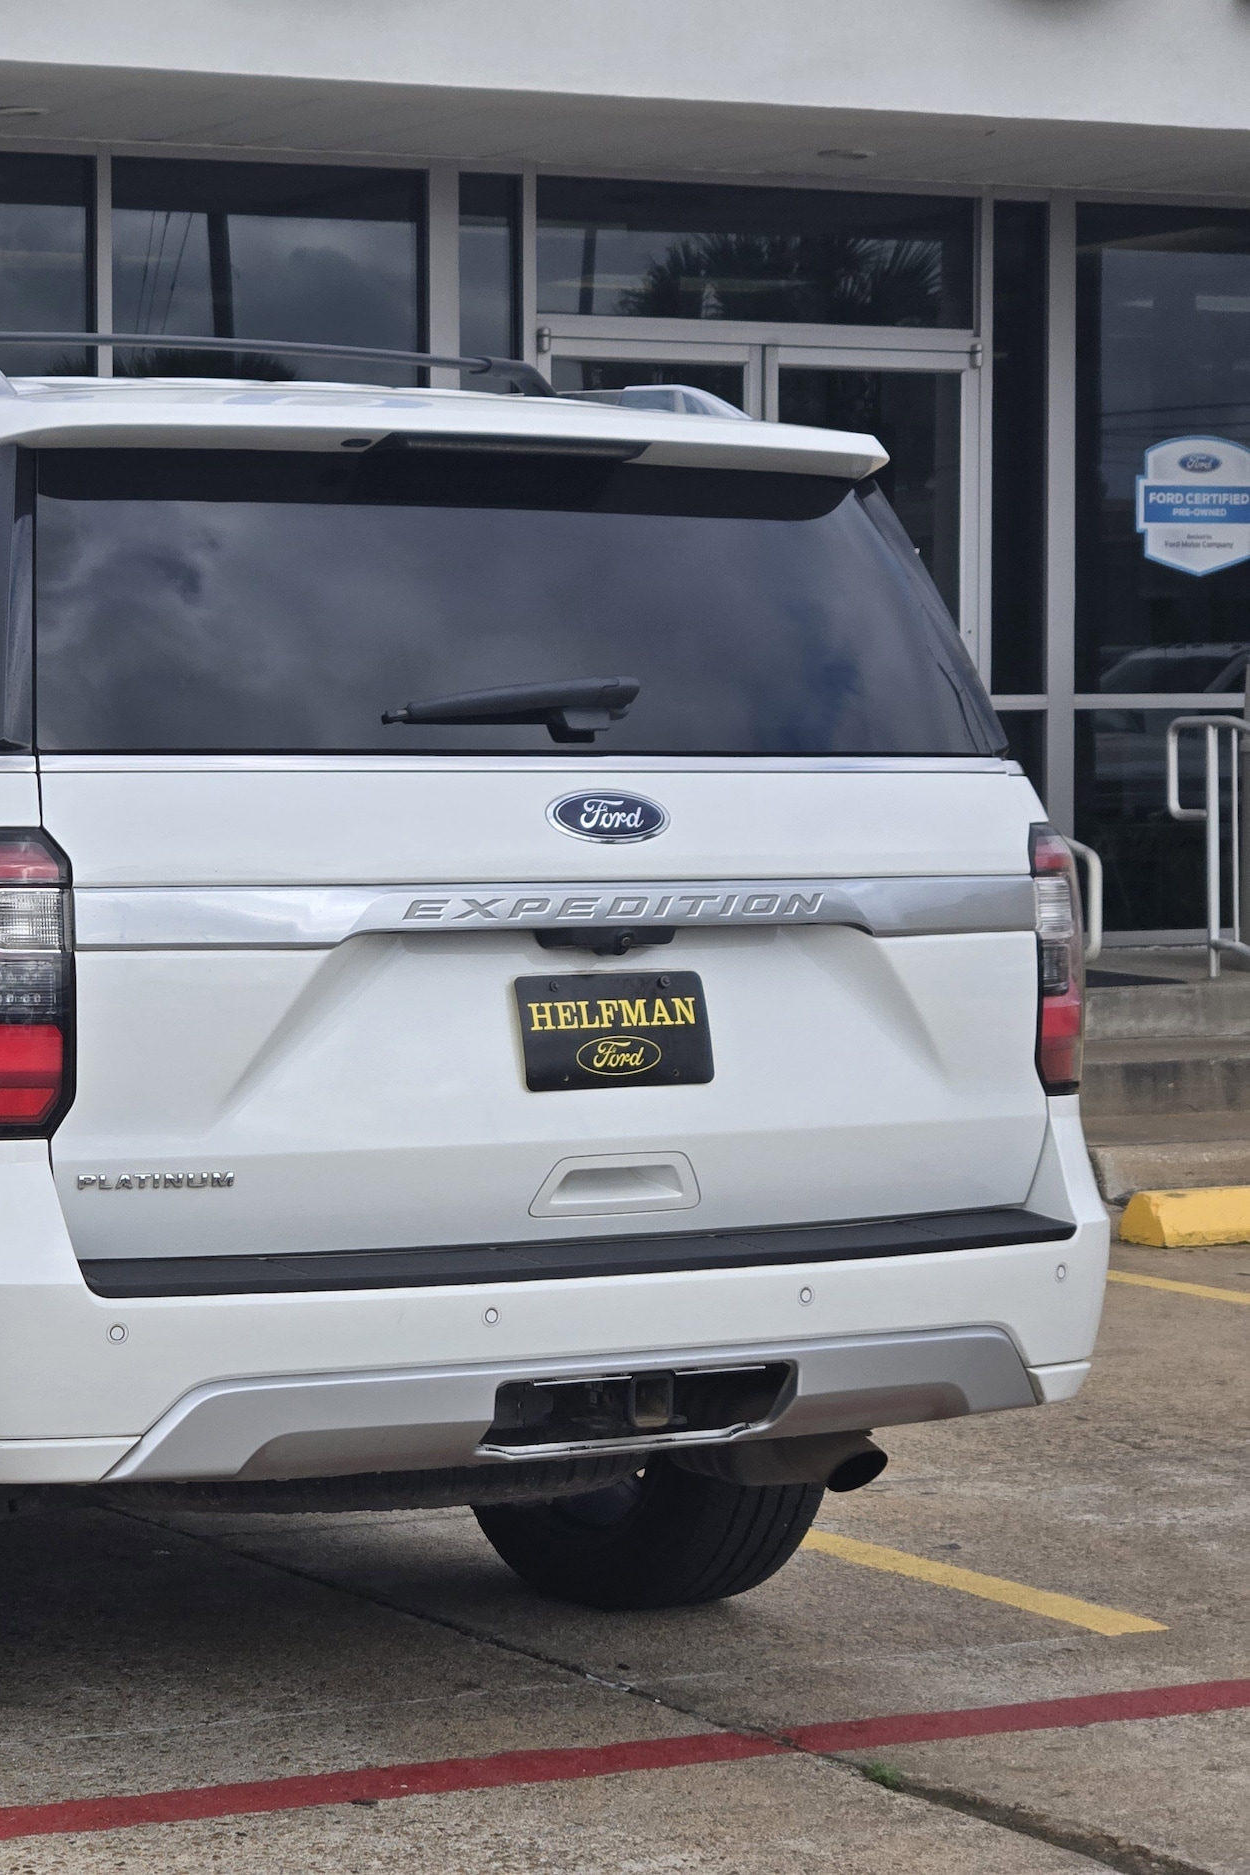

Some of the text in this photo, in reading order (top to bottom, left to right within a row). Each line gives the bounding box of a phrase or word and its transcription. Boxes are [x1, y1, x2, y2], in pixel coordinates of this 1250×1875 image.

[1149, 492, 1250, 505] FORD CERTIFIED
[1172, 508, 1227, 517] PRE-OWNED
[580, 799, 644, 828] Ford
[401, 893, 826, 921] EXPEDITION
[527, 997, 696, 1031] HELFMAN
[593, 1040, 645, 1068] Ford
[77, 1171, 235, 1190] PLATINUM
